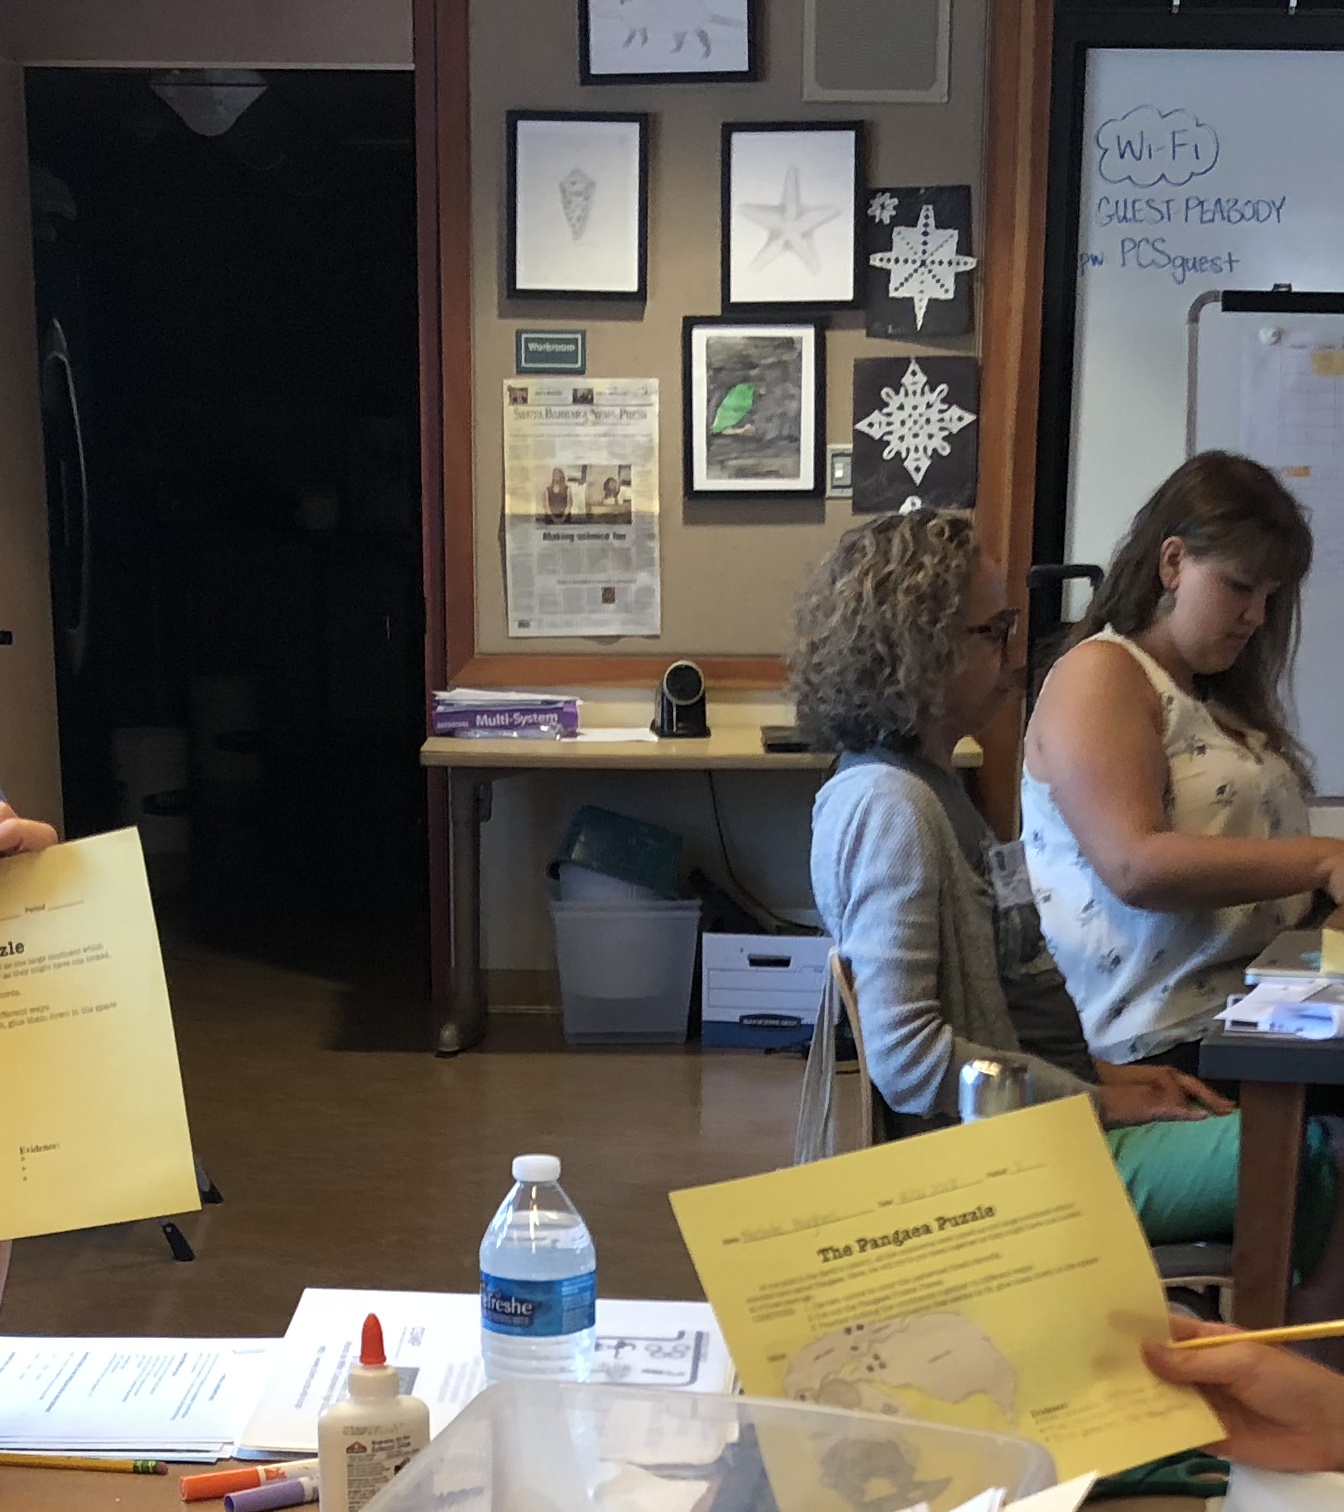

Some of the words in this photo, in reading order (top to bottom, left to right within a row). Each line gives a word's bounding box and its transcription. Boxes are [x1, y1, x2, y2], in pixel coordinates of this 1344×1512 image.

[1096, 196, 1174, 228] GUEST
[1183, 196, 1287, 224] PEABODY
[612, 531, 627, 541] fun
[476, 712, 558, 727] Multi-System
[816, 1244, 854, 1263] The
[855, 1223, 934, 1253] Pangaea
[934, 1204, 996, 1231] Puzzle
